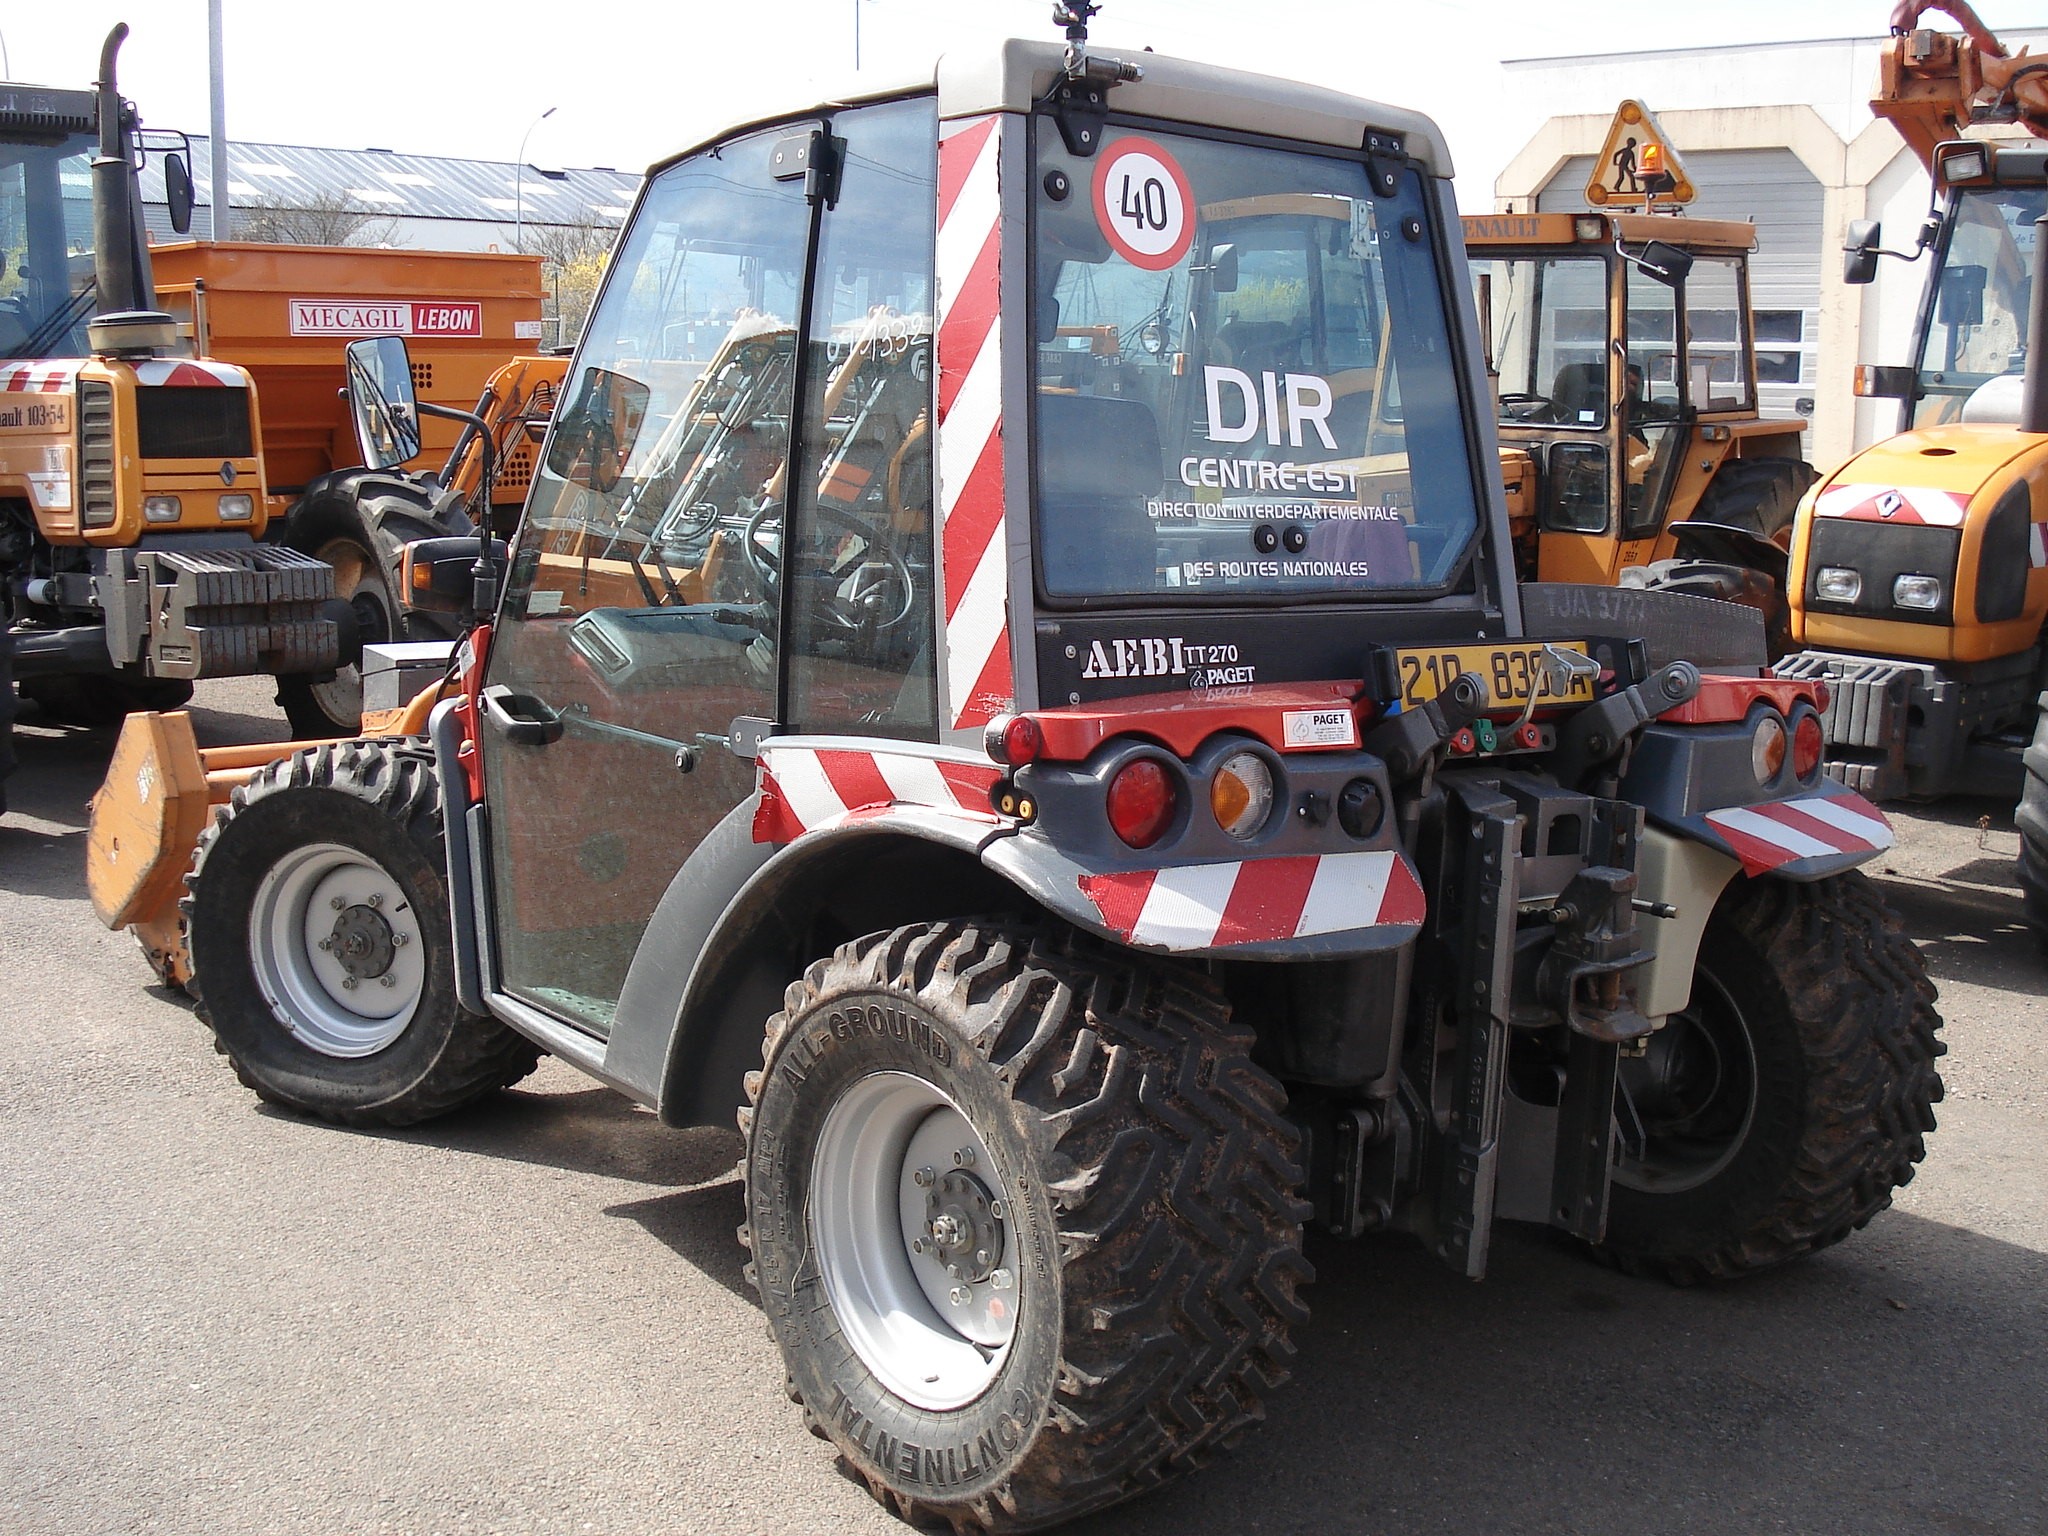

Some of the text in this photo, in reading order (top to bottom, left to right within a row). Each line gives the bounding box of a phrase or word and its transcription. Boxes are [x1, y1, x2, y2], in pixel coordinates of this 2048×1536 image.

[1120, 174, 1168, 231] 40
[1461, 217, 1541, 238] ENAULT
[299, 308, 474, 331] MECAGIL LEBON
[1203, 365, 1339, 450] DIR
[1179, 457, 1360, 493] CENTRE-EST
[1147, 502, 1399, 521] DIRECTION INTERDEPARTEMENTALE
[1183, 561, 1369, 577] DES ROUTES NATIONALES
[1082, 637, 1186, 679] AEBI
[1208, 644, 1239, 663] 270
[1206, 666, 1256, 686] PAGET
[1313, 714, 1345, 726] PAGET
[782, 1004, 951, 1097] ALL-GROUND
[827, 1379, 1033, 1487] CONTINENTAL
